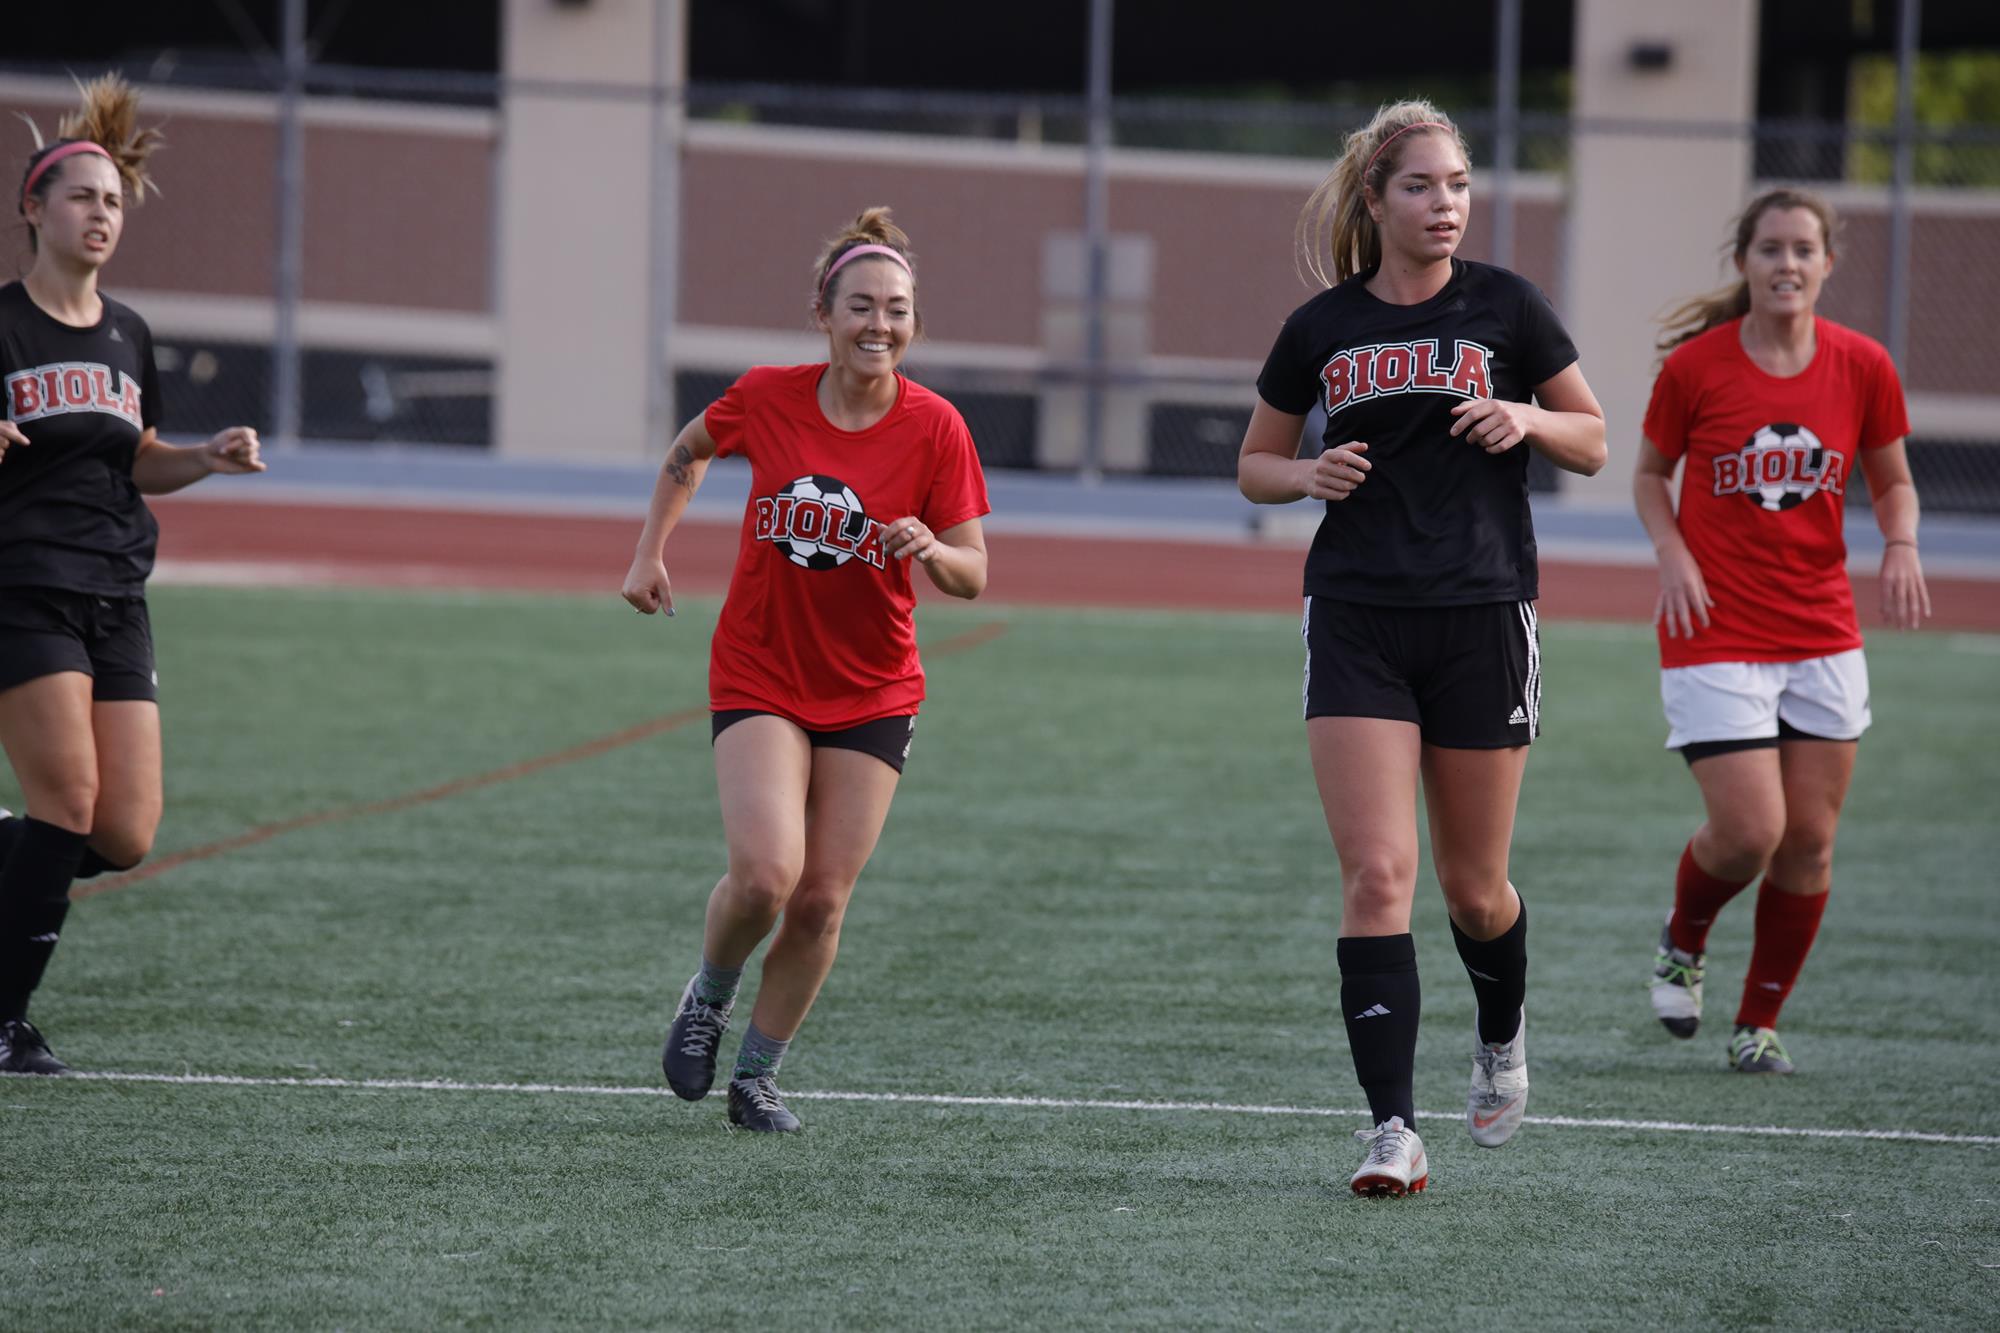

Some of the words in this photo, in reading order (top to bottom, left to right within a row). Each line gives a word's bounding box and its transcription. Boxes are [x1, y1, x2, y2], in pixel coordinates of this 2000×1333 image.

[5, 361, 143, 432] BIOLA
[1320, 338, 1493, 418] BIOLA
[1713, 446, 1844, 496] BIOLA
[756, 495, 886, 570] BIOLA
